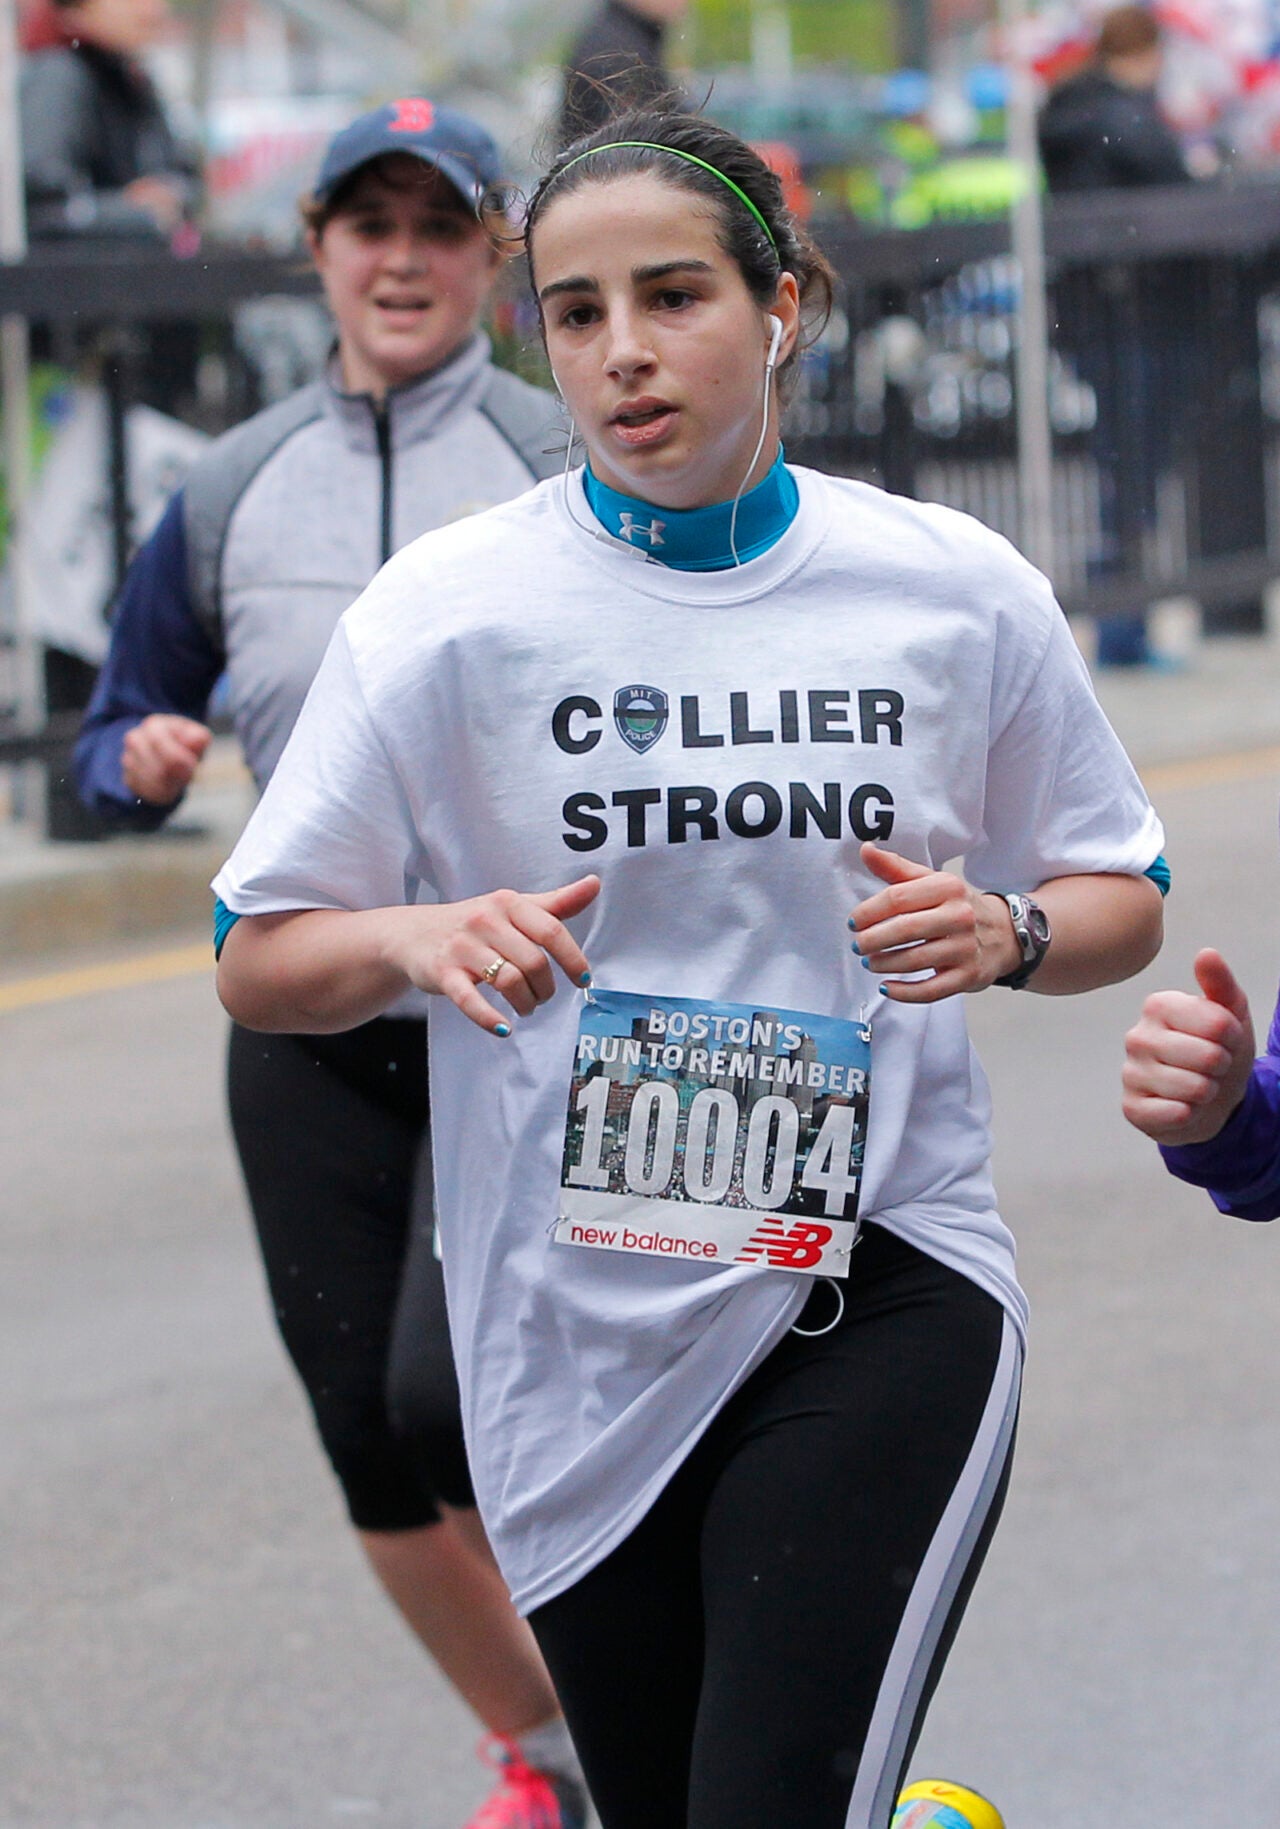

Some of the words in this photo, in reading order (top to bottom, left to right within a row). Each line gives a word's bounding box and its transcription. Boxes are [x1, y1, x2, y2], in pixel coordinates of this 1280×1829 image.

[387, 98, 436, 132] B
[629, 689, 653, 699] MIT
[551, 685, 905, 755] CLLIER
[625, 728, 657, 742] POLICE
[561, 781, 895, 852] STRONG
[648, 1009, 802, 1050] BOSTON'S
[577, 1034, 641, 1066] RUN
[647, 1042, 684, 1071] TO
[689, 1048, 866, 1093] REMEMBER
[569, 1075, 856, 1217] 10004
[571, 1223, 617, 1245] new
[622, 1228, 718, 1258] balance
